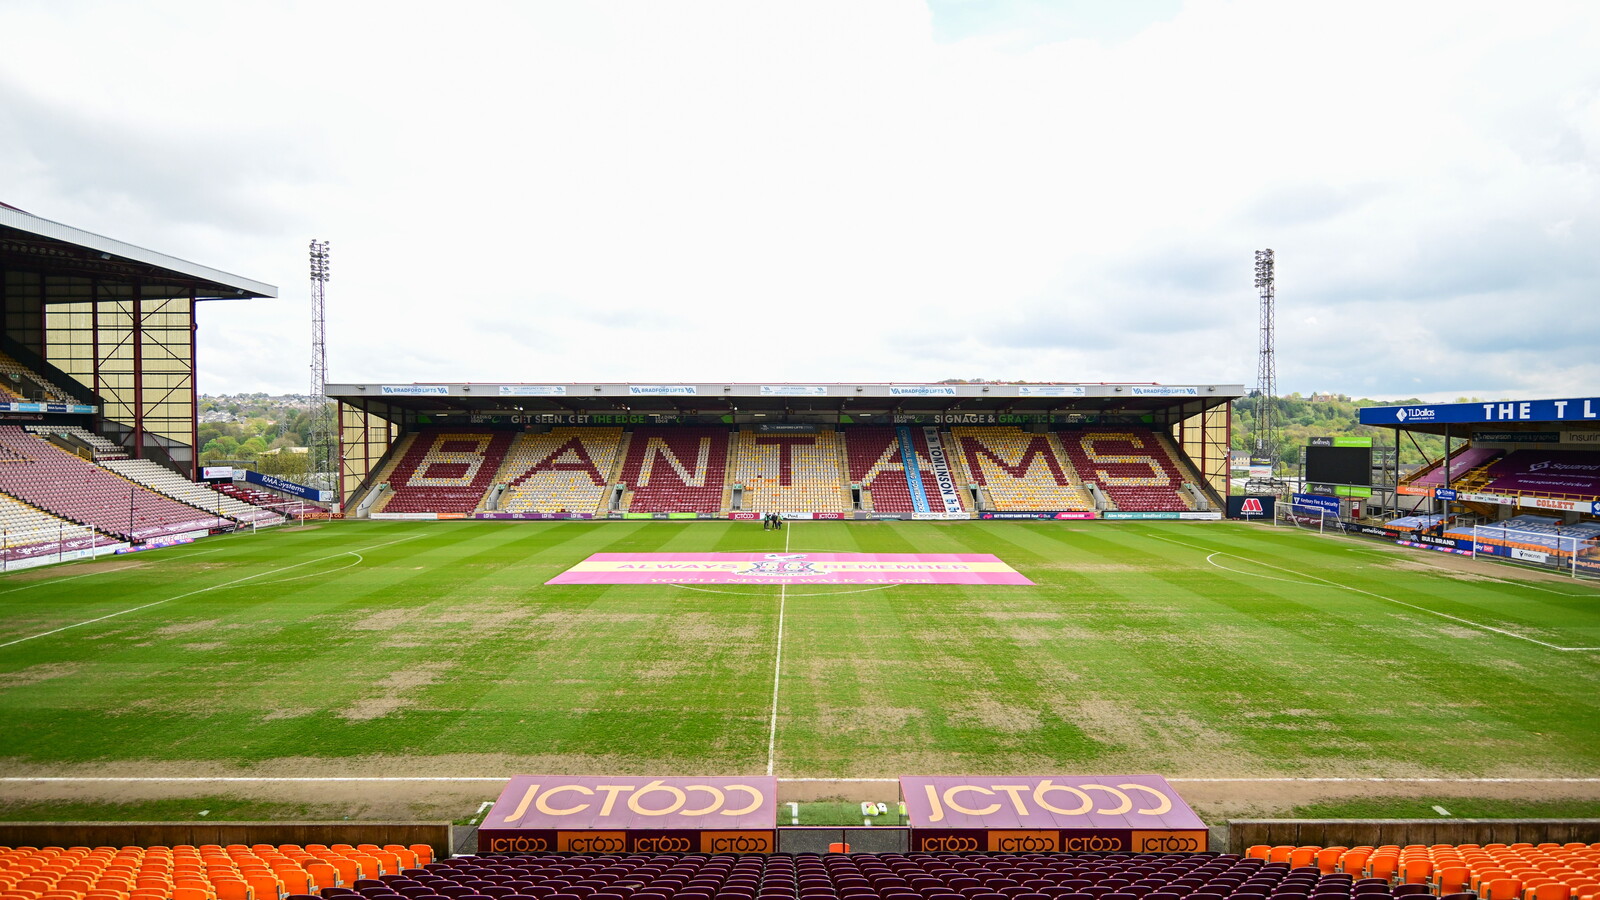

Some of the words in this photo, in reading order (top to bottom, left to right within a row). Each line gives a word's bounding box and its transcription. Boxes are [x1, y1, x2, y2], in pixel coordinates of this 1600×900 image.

[511, 414, 532, 424] GET
[535, 414, 565, 424] SEEN.
[568, 414, 589, 424] GET
[592, 414, 613, 424] THE
[934, 414, 984, 423] SIGNAGE
[987, 414, 995, 423] &
[1483, 402, 1530, 420] THE
[930, 446, 955, 495] TOMLINSON
[261, 474, 278, 486] RMA
[1536, 499, 1575, 510] COLLETT
[1435, 537, 1455, 545] BRAND
[503, 780, 764, 823] JCT600
[924, 779, 1173, 822] JCT600
[490, 836, 547, 852] JCT600
[568, 836, 625, 852] JCT600
[634, 836, 690, 852] JCT600
[711, 836, 767, 852] JCT600
[921, 834, 978, 852] JCT600
[998, 834, 1055, 852] JCT600
[1064, 834, 1121, 852] JCT600
[1141, 834, 1198, 852] JCT600
